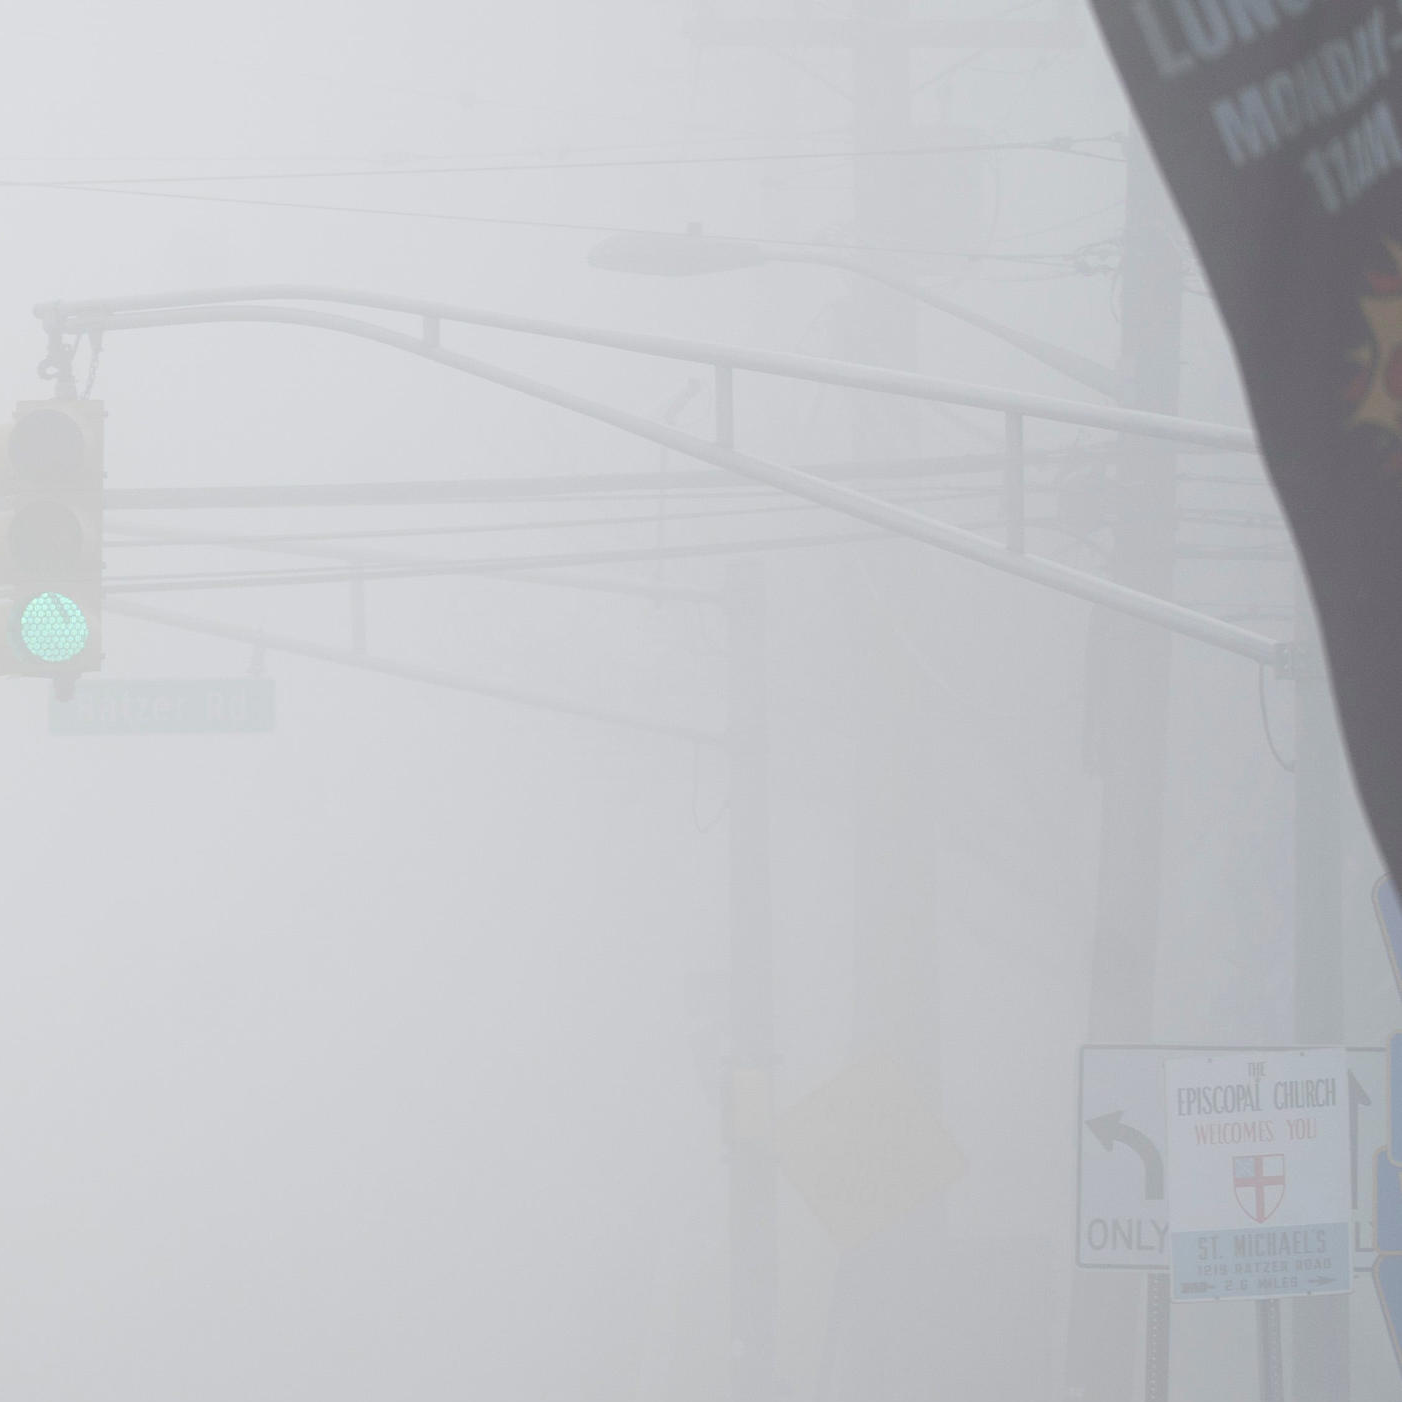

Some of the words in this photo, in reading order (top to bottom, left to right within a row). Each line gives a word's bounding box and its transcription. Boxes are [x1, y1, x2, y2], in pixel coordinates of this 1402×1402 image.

[205, 687, 249, 722] Rd
[1247, 1061, 1267, 1077] THE
[1177, 1080, 1263, 1116] EPISCOPAL
[1273, 1078, 1337, 1110] CHURCH
[1195, 1120, 1274, 1145] WELCOMES
[1286, 1118, 1317, 1141] YOU
[1087, 1218, 1170, 1253] ONLY
[1197, 1236, 1224, 1261] ST.
[1296, 1257, 1333, 1271] ROAD
